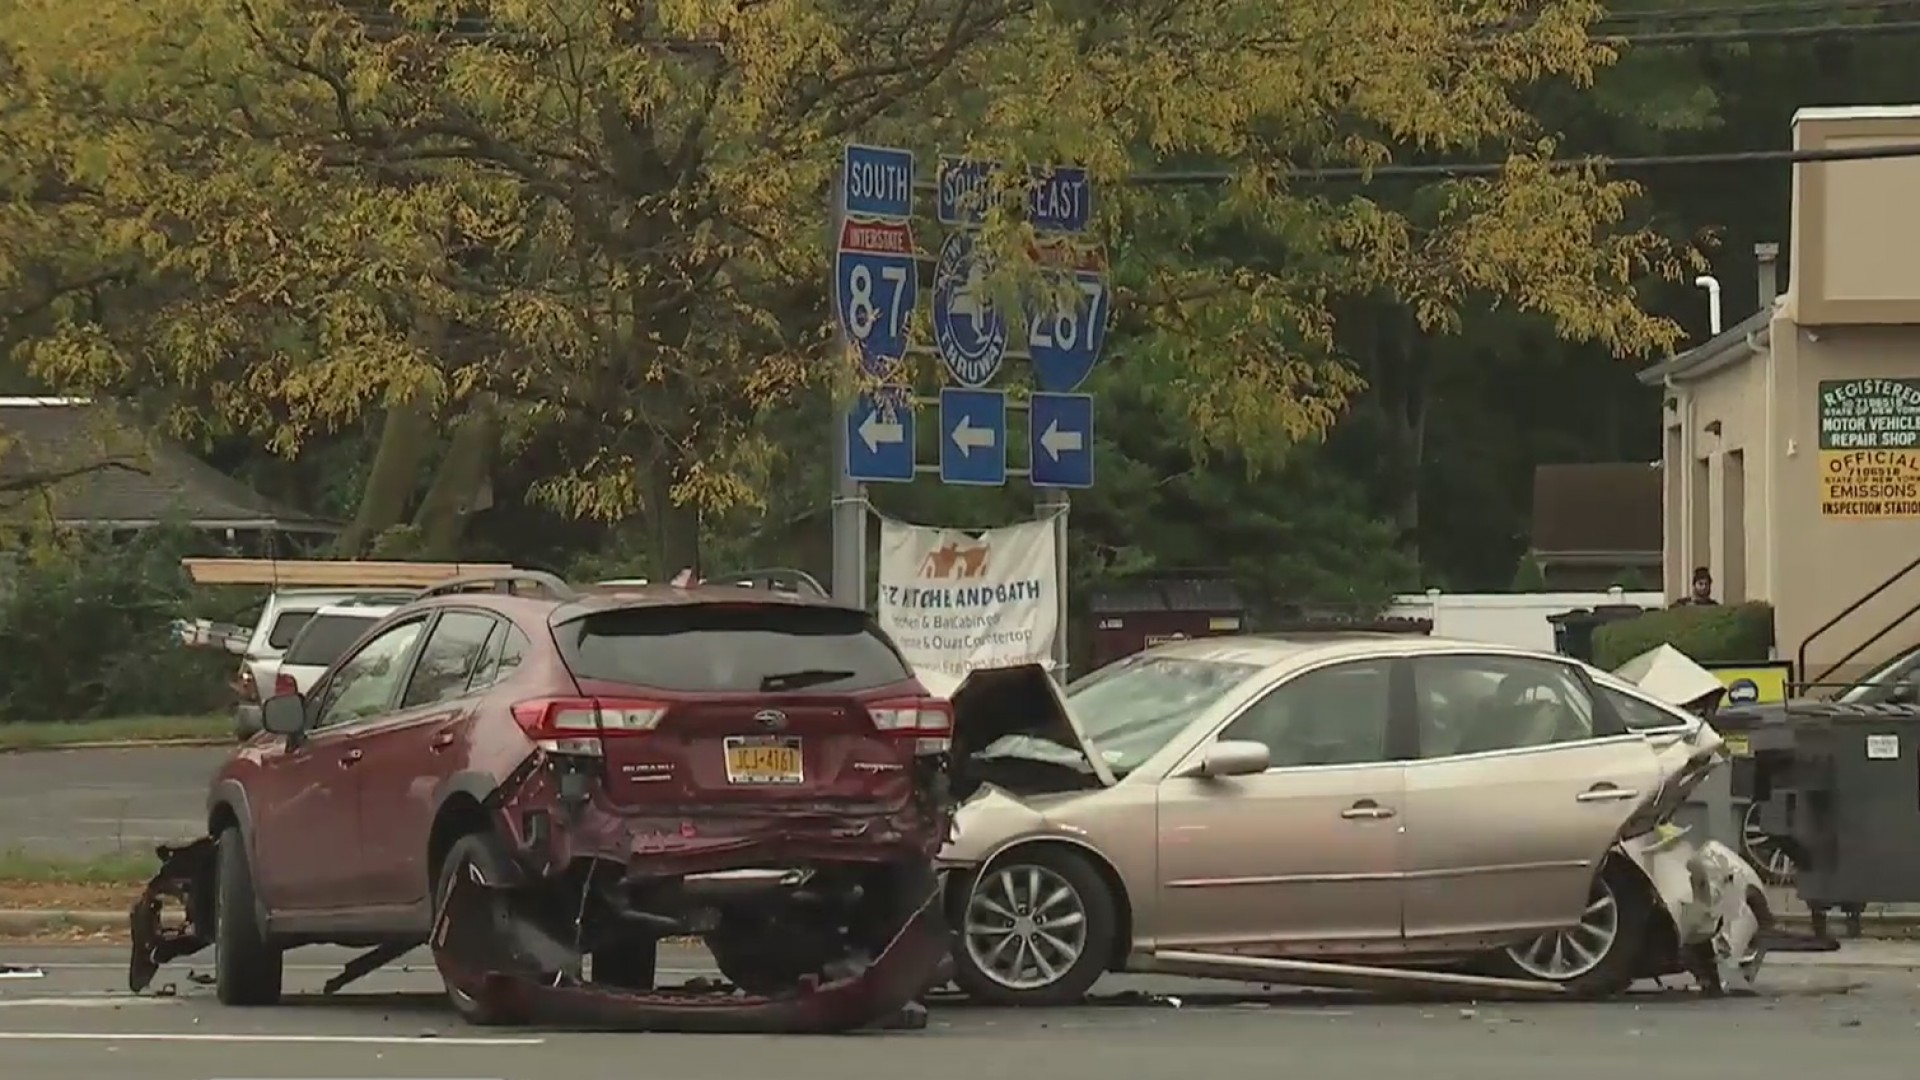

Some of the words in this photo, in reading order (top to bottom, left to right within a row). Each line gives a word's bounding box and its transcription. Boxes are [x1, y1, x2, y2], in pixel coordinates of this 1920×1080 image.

[851, 161, 907, 201] SOUTH
[944, 170, 1004, 210] SOU
[1037, 180, 1083, 217] EAST
[850, 229, 905, 251] INTERSTATE
[850, 264, 907, 339] 87
[1824, 379, 1920, 406] REGISTERED
[1823, 417, 1866, 432] MOTOR
[1869, 415, 1920, 431] VEHICLE
[1831, 432, 1878, 447] REPAIR
[1881, 431, 1917, 446] SHOP
[1830, 451, 1919, 474] OFFICIAL
[1830, 483, 1917, 499] EMISSIONS
[1822, 501, 1882, 515] INSPECTION
[996, 580, 1039, 603] BATH
